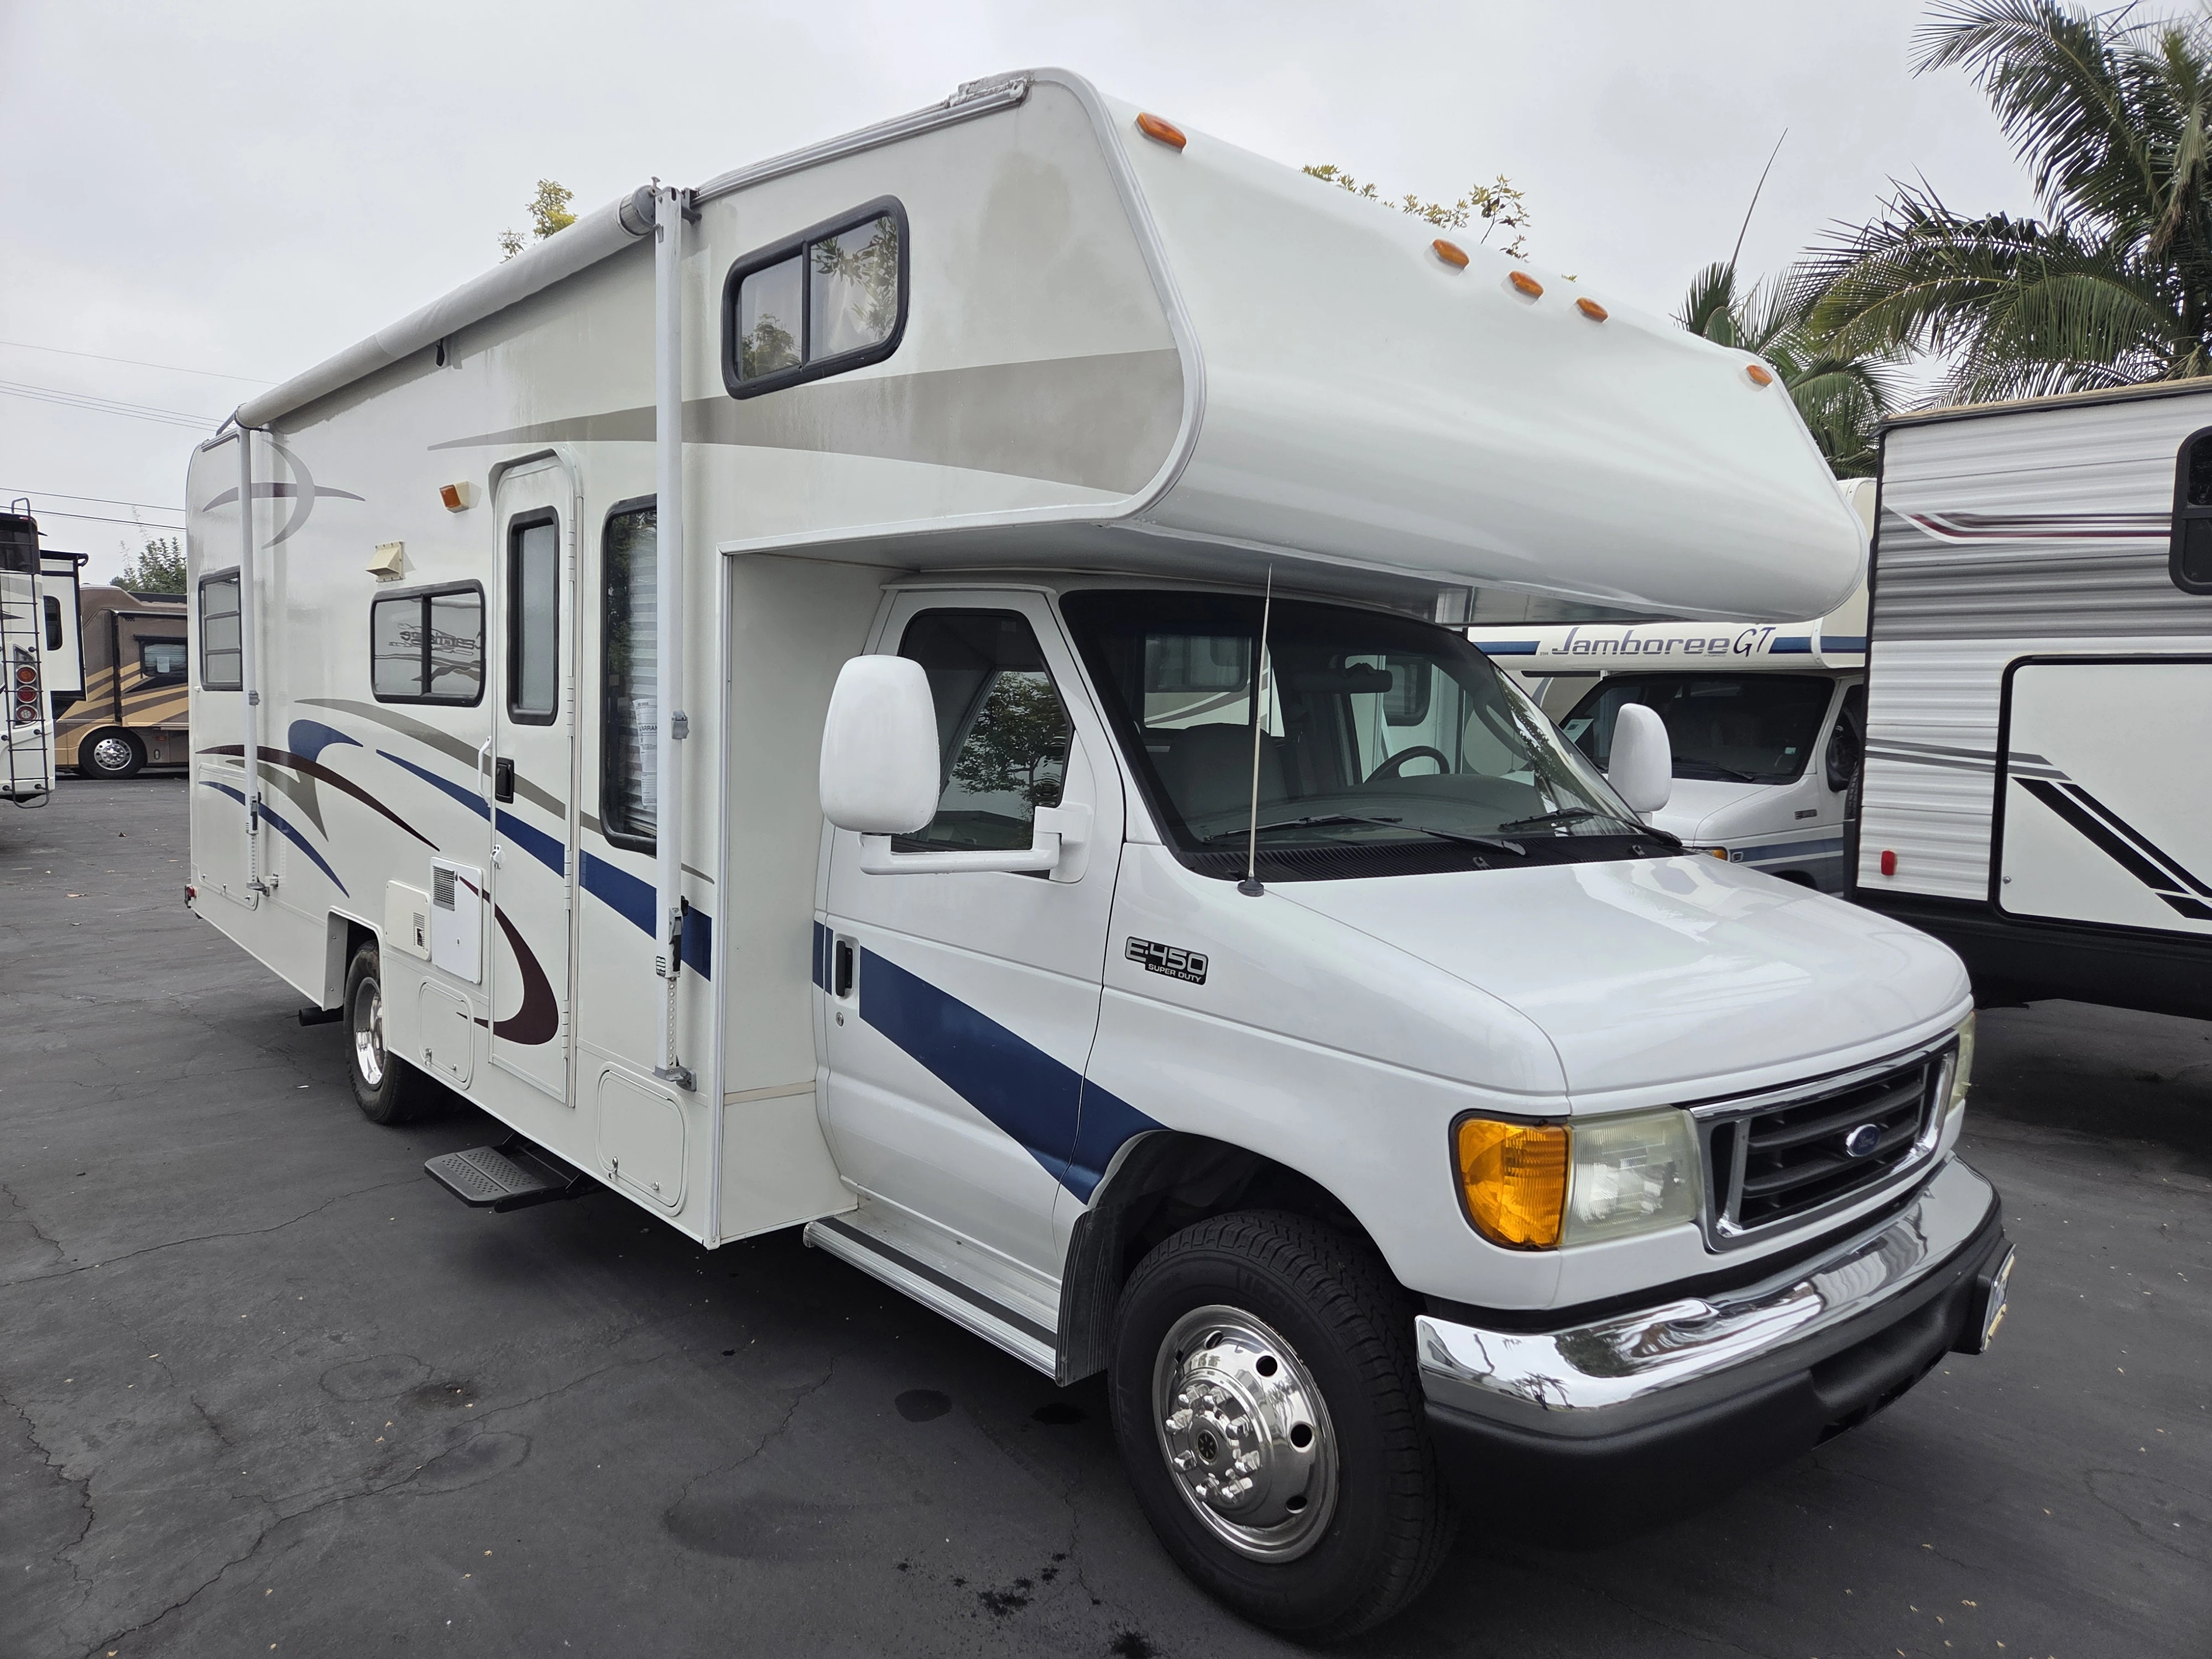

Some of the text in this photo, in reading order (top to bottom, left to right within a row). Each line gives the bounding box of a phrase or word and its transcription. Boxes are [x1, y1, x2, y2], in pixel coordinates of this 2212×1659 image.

[1552, 627, 1776, 658] Jamboree GT
[1148, 963, 1202, 983] SUPER DUTY
